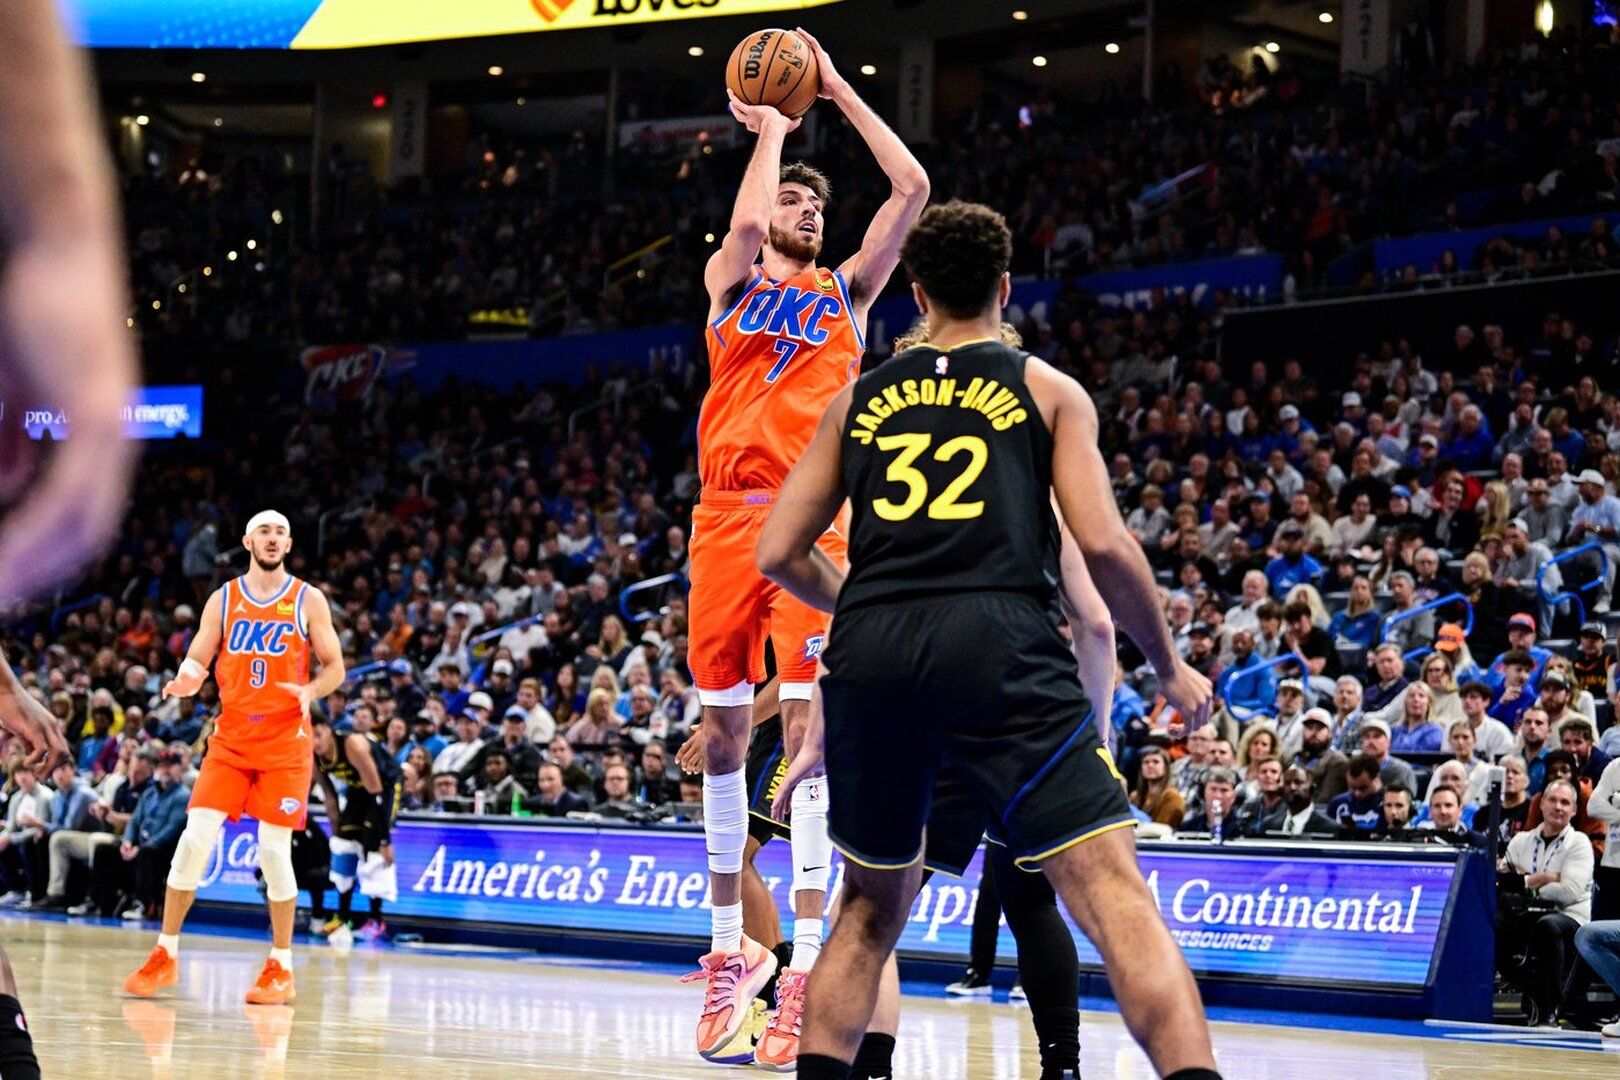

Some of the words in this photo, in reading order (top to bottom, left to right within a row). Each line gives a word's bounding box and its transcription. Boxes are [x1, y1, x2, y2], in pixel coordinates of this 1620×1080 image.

[737, 286, 841, 345] OKC
[764, 338, 799, 384] 7
[850, 377, 1028, 445] JACKSON-DAVIS
[872, 432, 988, 522] 32
[228, 618, 296, 656] OKC
[249, 658, 267, 689] 9
[412, 844, 609, 903] America's
[1172, 878, 1423, 934] Continental
